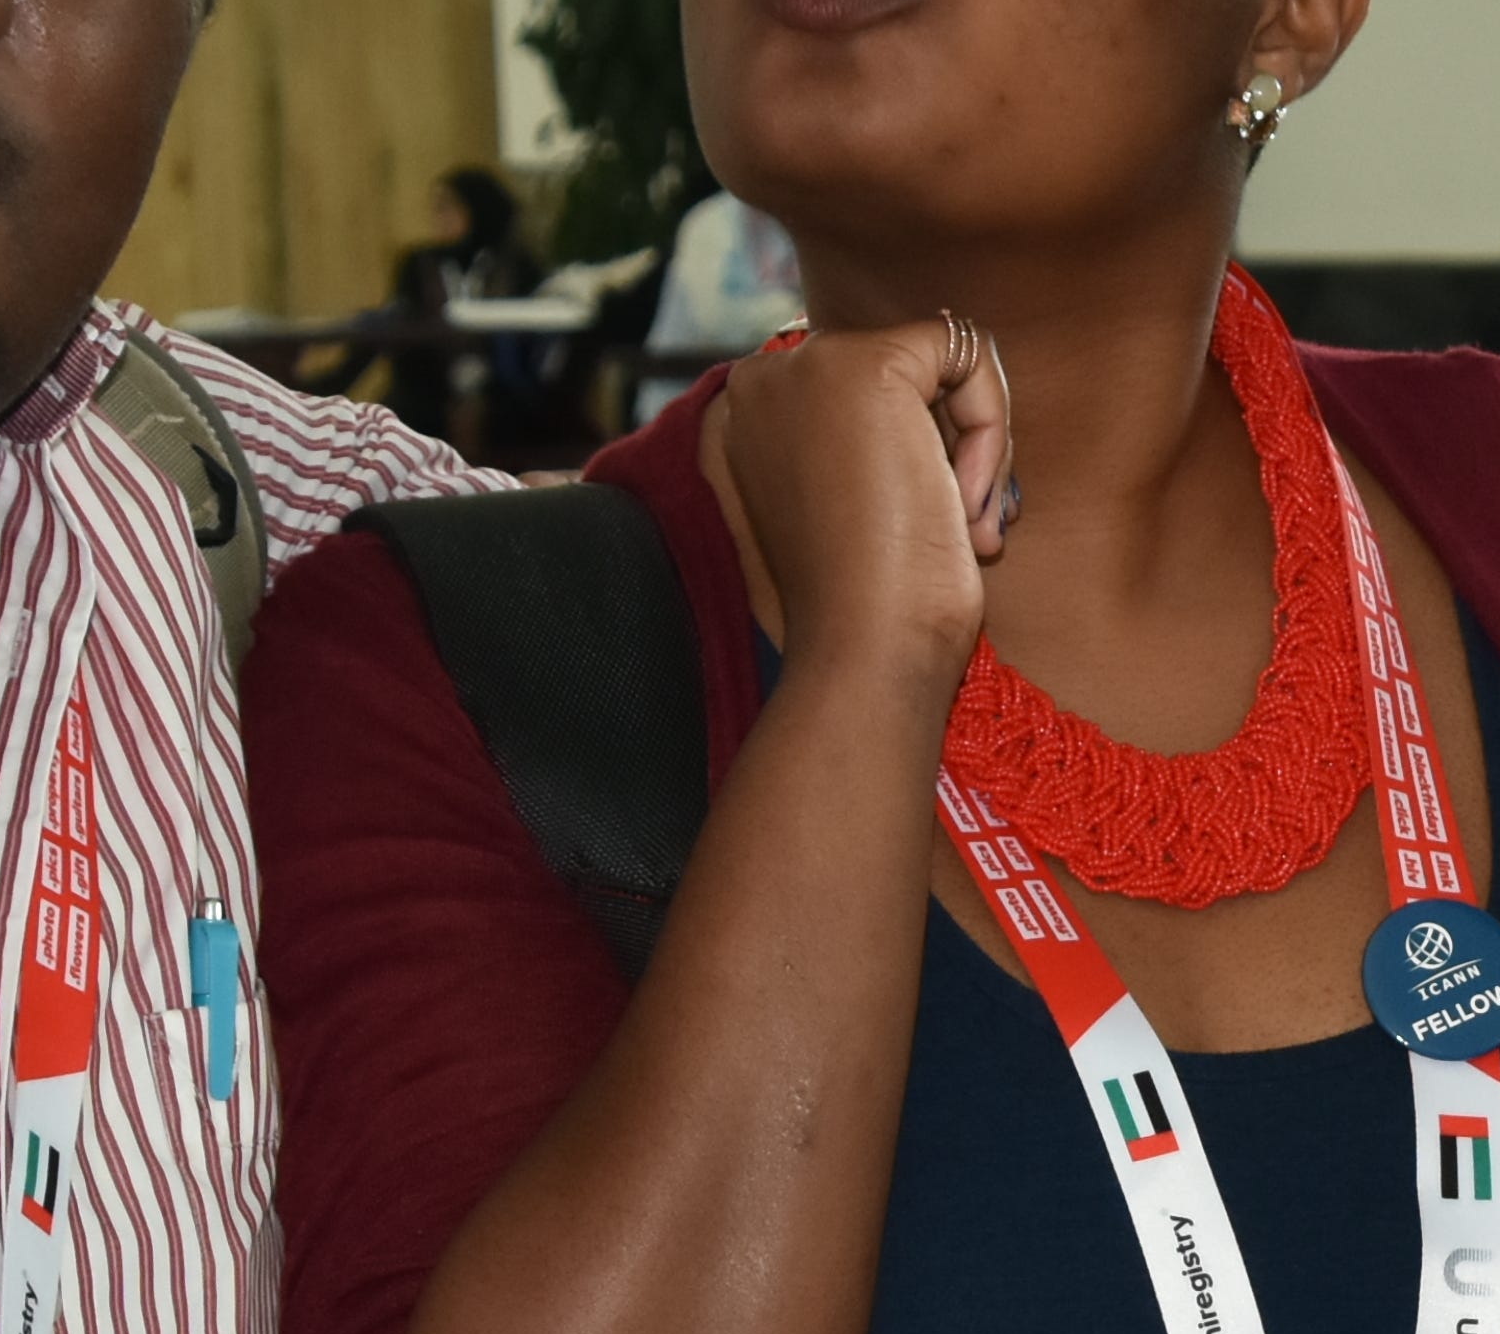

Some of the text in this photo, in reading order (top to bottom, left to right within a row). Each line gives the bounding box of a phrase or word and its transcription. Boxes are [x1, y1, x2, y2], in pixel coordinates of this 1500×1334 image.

[1411, 746, 1440, 839] .blackfriday
[41, 906, 56, 965] .photo
[70, 913, 86, 986] .flowers
[1419, 964, 1481, 1001] ICANN
